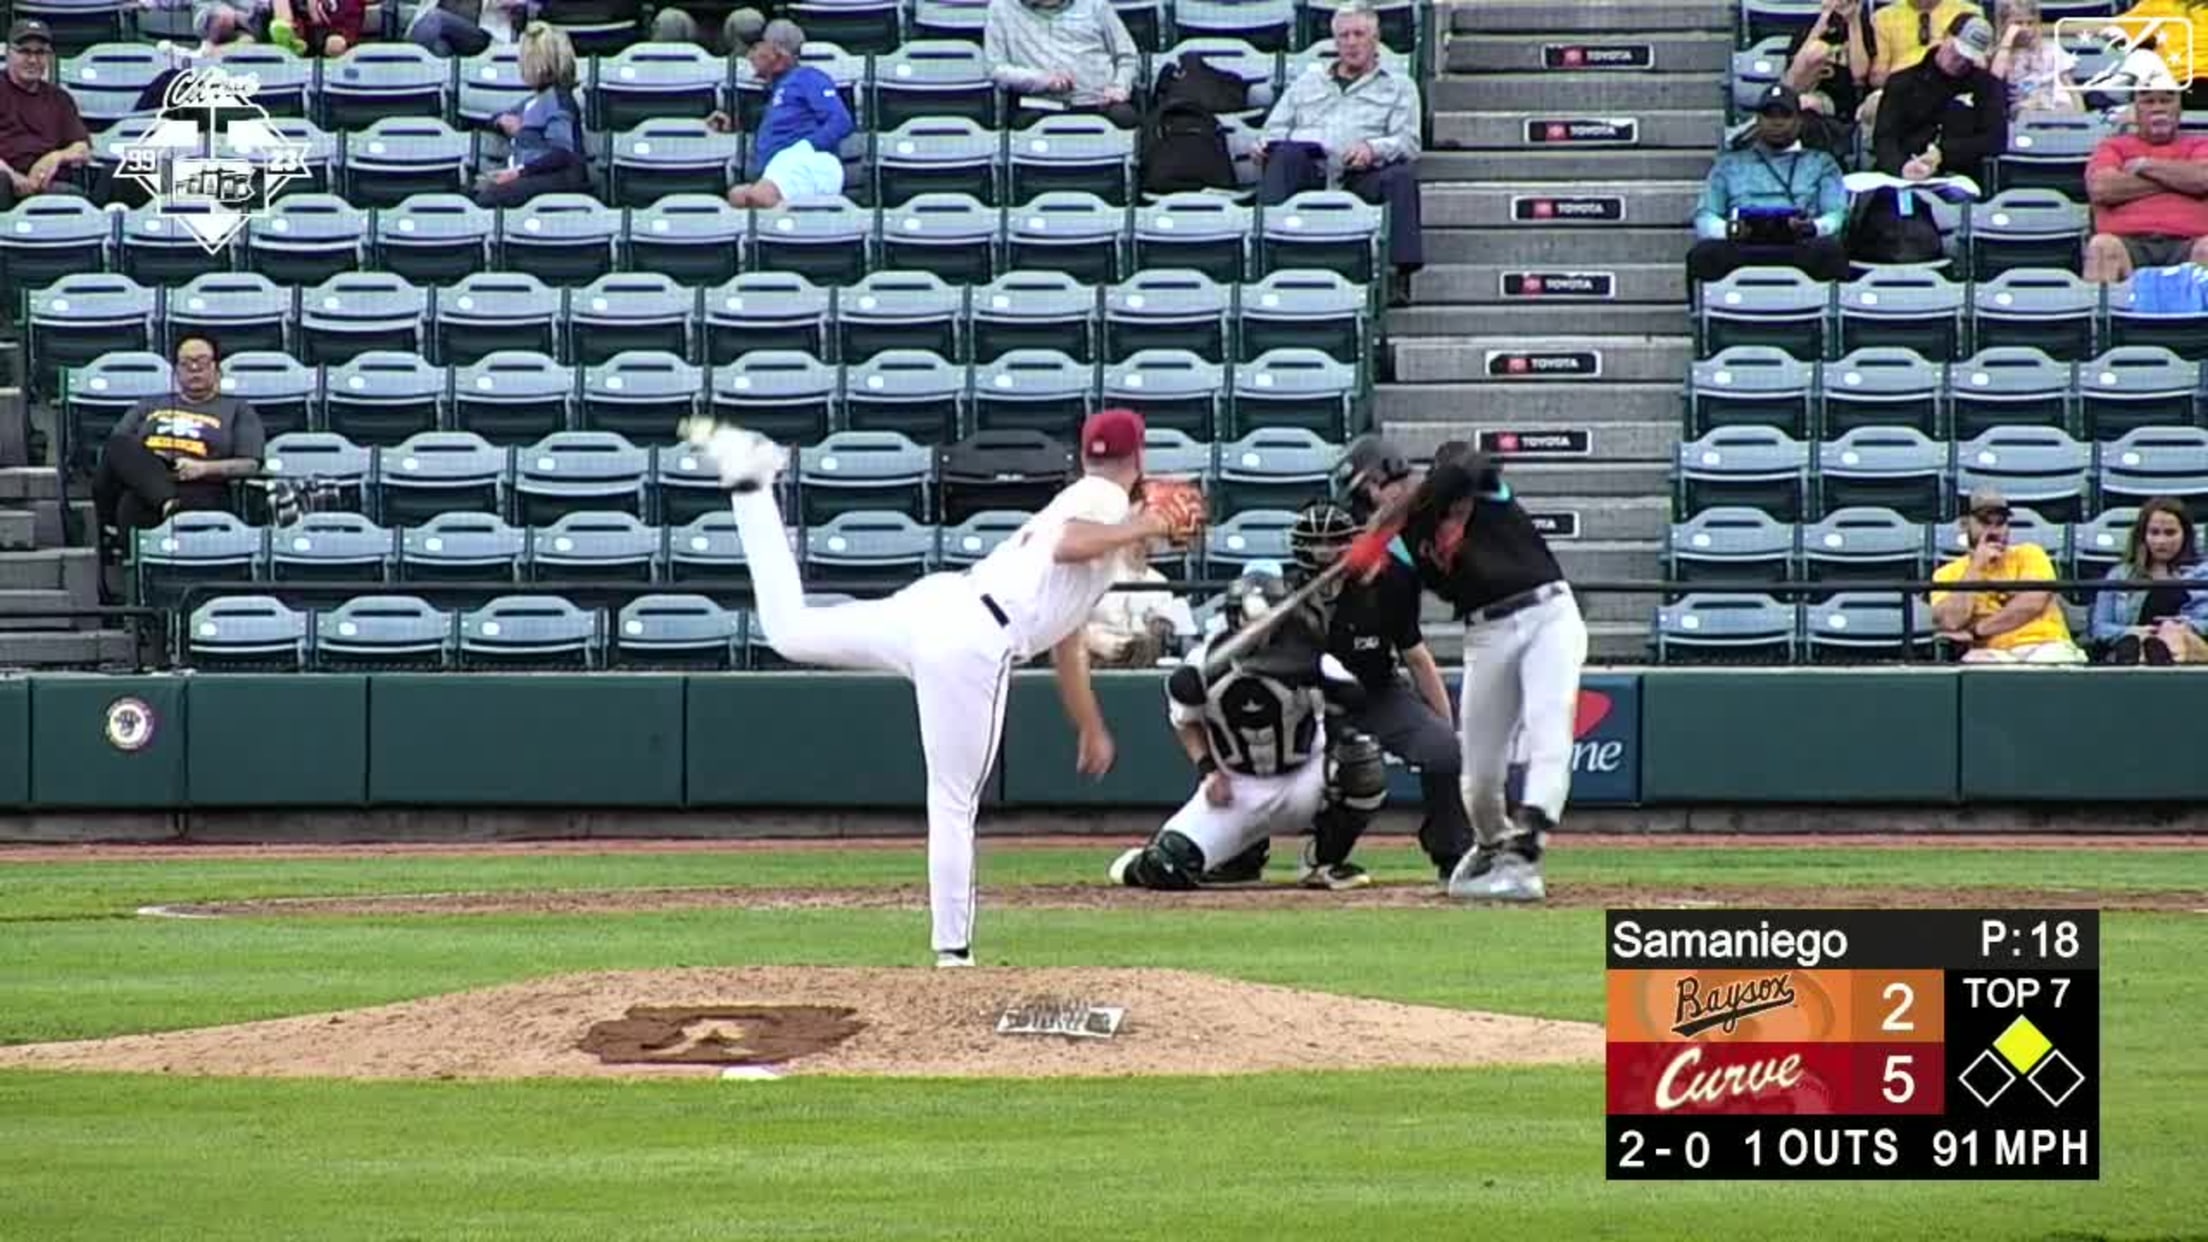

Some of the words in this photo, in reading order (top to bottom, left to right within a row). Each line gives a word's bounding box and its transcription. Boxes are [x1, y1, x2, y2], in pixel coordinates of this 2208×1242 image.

[1586, 50, 1633, 61] TOYOTA
[1569, 125, 1618, 136] TOYOTA
[1556, 202, 1605, 214] TOYOTA
[1545, 278, 1593, 290] TOYOTA
[1531, 357, 1580, 369] TOYOTA
[1520, 436, 1571, 448] TOYOTA
